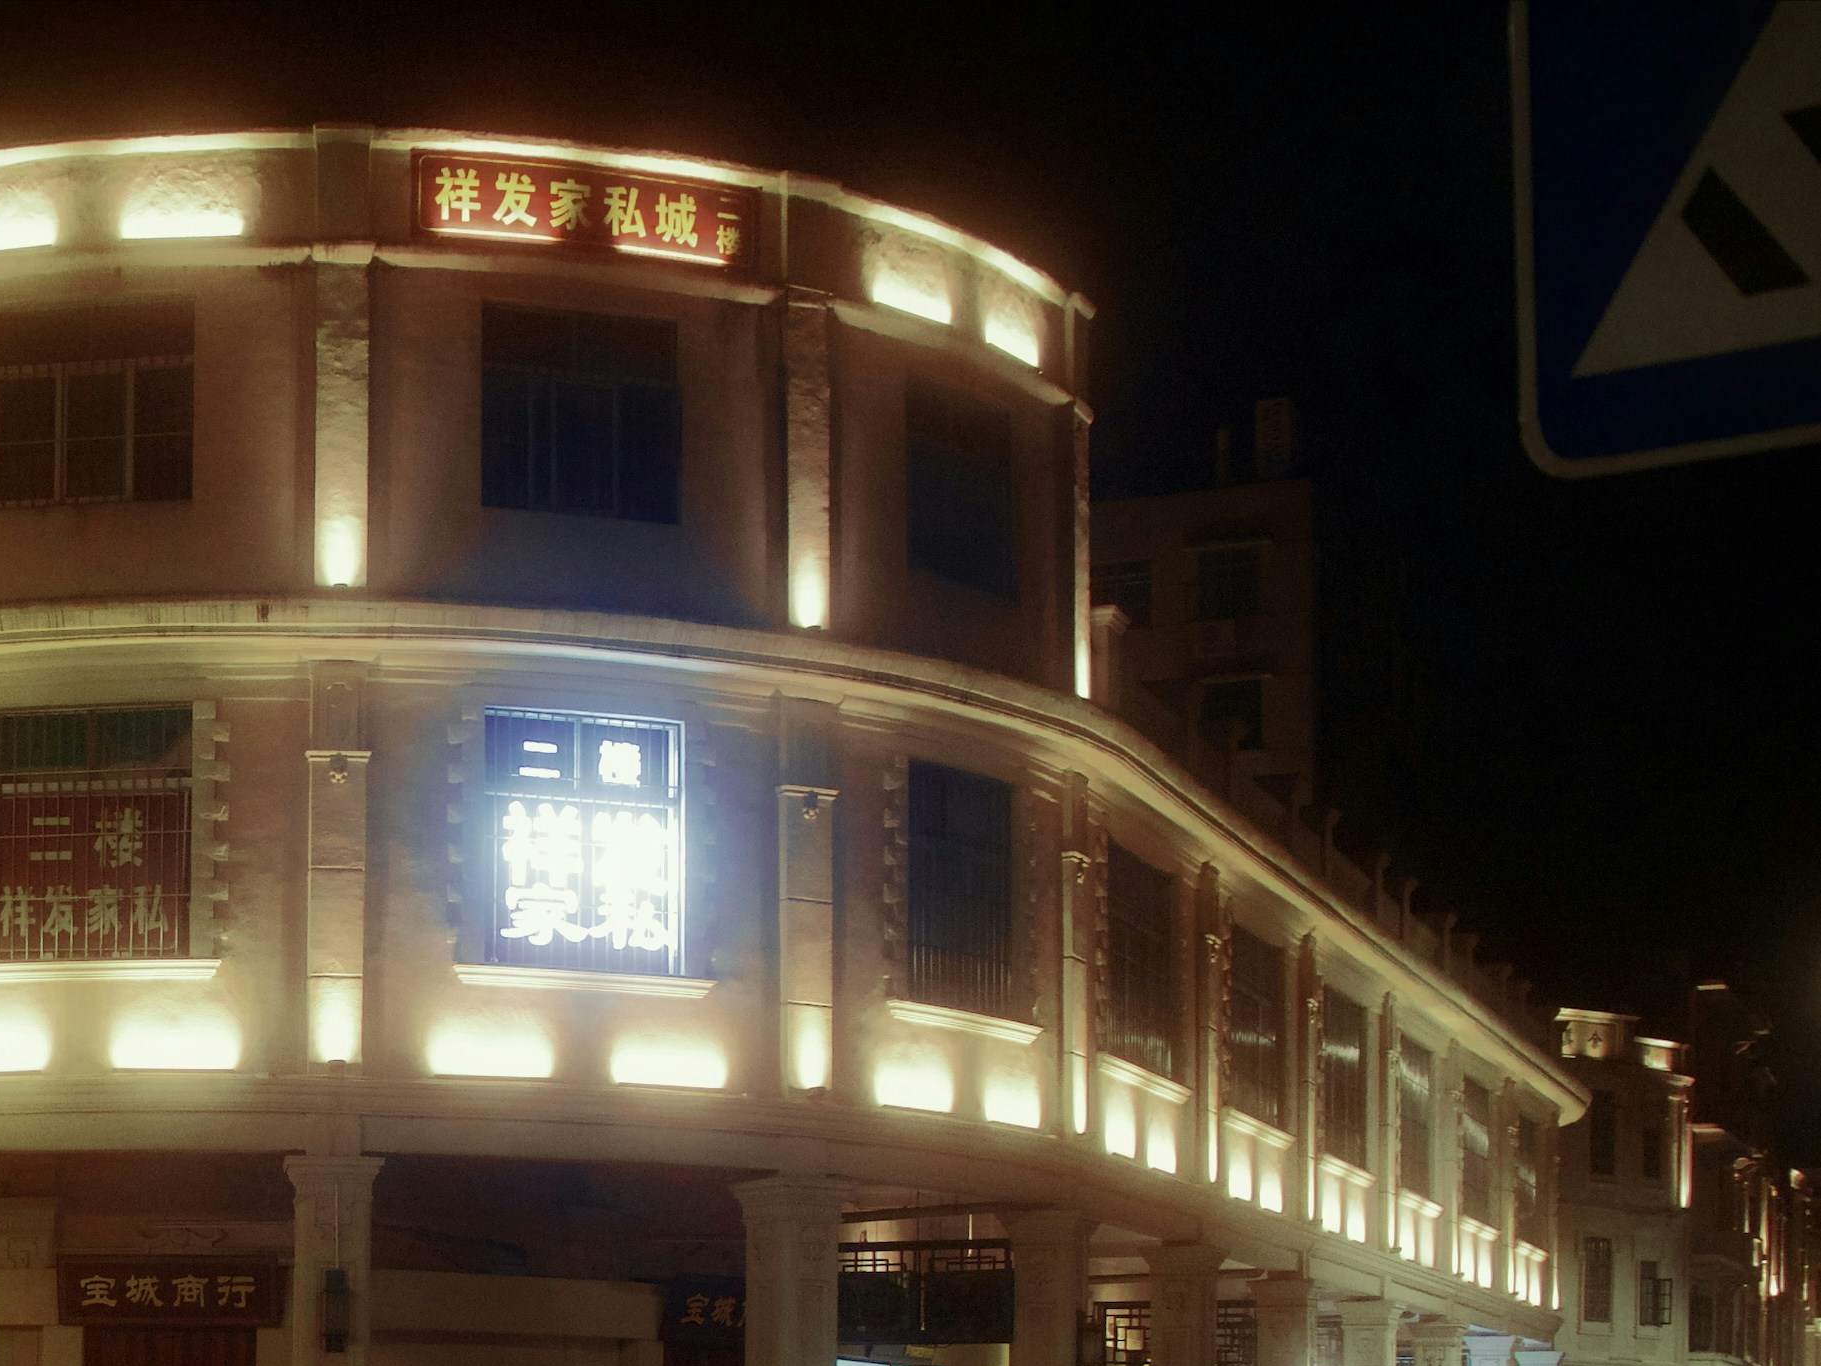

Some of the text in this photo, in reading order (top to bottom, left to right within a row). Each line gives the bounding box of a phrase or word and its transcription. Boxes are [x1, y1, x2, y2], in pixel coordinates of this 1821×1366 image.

[434, 166, 698, 249] 祥发家私城
[29, 808, 144, 868] 二楼
[0, 884, 169, 938] 祥发家私
[80, 1274, 257, 1309] 宝城商行
